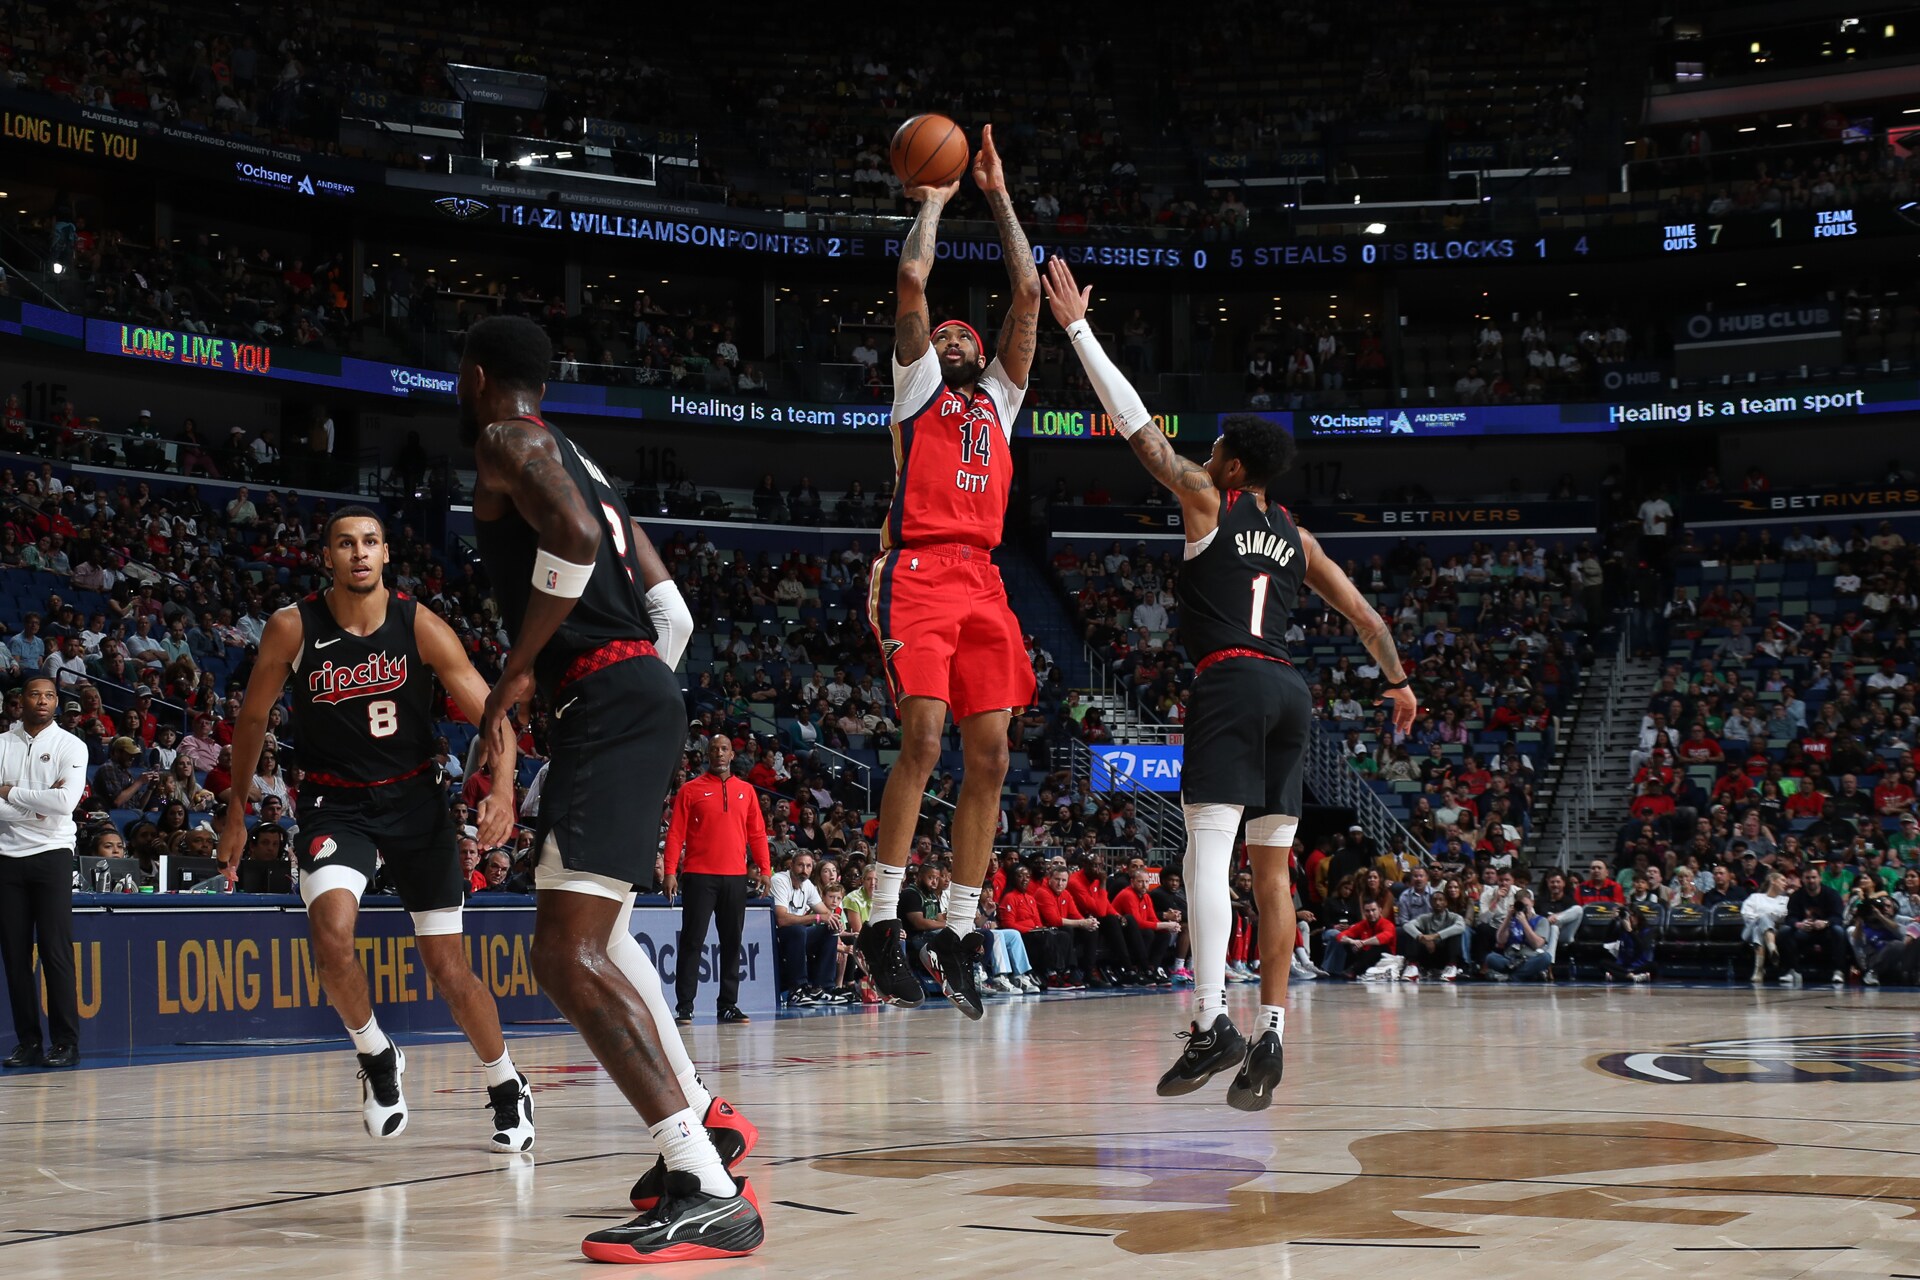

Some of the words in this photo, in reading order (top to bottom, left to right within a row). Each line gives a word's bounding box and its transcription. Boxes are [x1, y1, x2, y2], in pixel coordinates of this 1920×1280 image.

[420, 101, 447, 115] 320
[81, 110, 118, 125] PLAYERS
[118, 118, 139, 129] PASS
[3, 111, 52, 144] LONG
[56, 123, 95, 153] LIVE
[101, 132, 138, 161] YOU
[163, 127, 225, 148] PLAYER-FUNDED
[226, 140, 271, 157] COMMUNITY
[272, 149, 301, 162] TICKETS
[242, 163, 294, 184] Ochsner
[316, 179, 355, 194] ANDREWS
[481, 183, 516, 196] PLAYERS
[516, 187, 537, 197] PASS
[560, 192, 622, 207] PLAYER-FUNDED
[623, 200, 669, 211] COMMUNITY
[668, 204, 700, 215] TICKETS
[1769, 217, 1784, 239] 1
[1815, 209, 1854, 225] TEAM
[1663, 223, 1697, 239] TIME
[1707, 223, 1724, 245] 7
[1813, 222, 1858, 238] FOULS
[1193, 249, 1208, 270] 0
[1253, 244, 1348, 265] STEALS
[1534, 237, 1548, 259] 1
[1662, 237, 1698, 251] OUTS
[1718, 313, 1766, 333] HUB
[1767, 308, 1830, 328] CLUB
[121, 325, 175, 361] LONG
[180, 334, 224, 368] LIVE
[230, 341, 271, 374] YOU
[398, 370, 455, 392] Ochsner
[1625, 371, 1662, 386] HUB
[670, 395, 745, 422] Healing
[750, 402, 765, 420] is
[770, 407, 783, 422] a
[787, 405, 836, 426] team
[1609, 402, 1692, 424] Healing
[1697, 399, 1715, 418] is
[1720, 401, 1737, 417] a
[1740, 395, 1797, 415] team
[1802, 388, 1865, 413] sport
[1032, 411, 1085, 437] LONG
[1319, 413, 1385, 429] Ochsner
[1414, 412, 1468, 424] ANDREWS
[958, 421, 991, 467] 14
[955, 469, 990, 493] CITY
[1770, 489, 1920, 510] BETRIVERS
[1382, 508, 1522, 525] BETRIVERS
[1234, 529, 1296, 568] SIMONS
[1249, 571, 1272, 641] 1
[308, 649, 408, 706] ripcity
[367, 699, 399, 739] 8
[157, 938, 261, 1015] LONG
[355, 936, 418, 1004] THE
